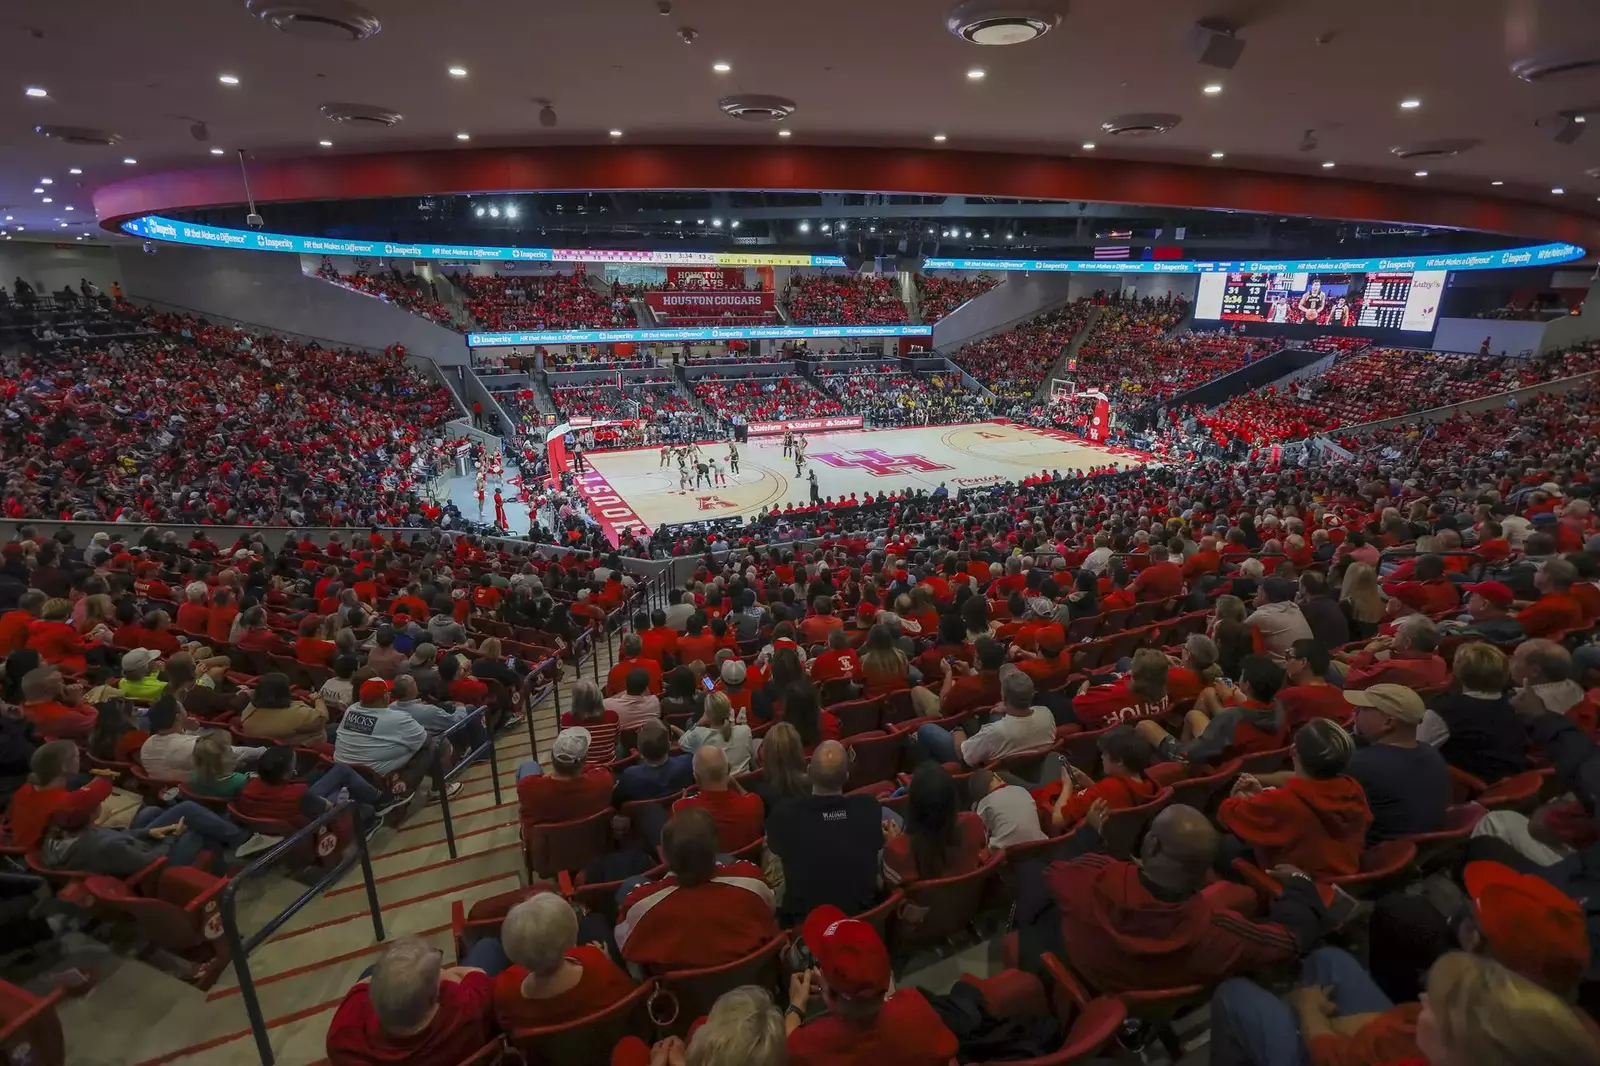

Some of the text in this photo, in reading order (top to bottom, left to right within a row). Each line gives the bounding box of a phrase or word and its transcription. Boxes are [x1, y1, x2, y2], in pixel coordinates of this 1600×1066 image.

[264, 237, 293, 250] Insperity
[312, 241, 323, 249] that
[393, 245, 421, 255] Insperity
[1508, 252, 1532, 263] Insperity
[1387, 260, 1416, 270] Insperity
[663, 297, 713, 305] HOUSTON
[1223, 295, 1242, 303] 3:34
